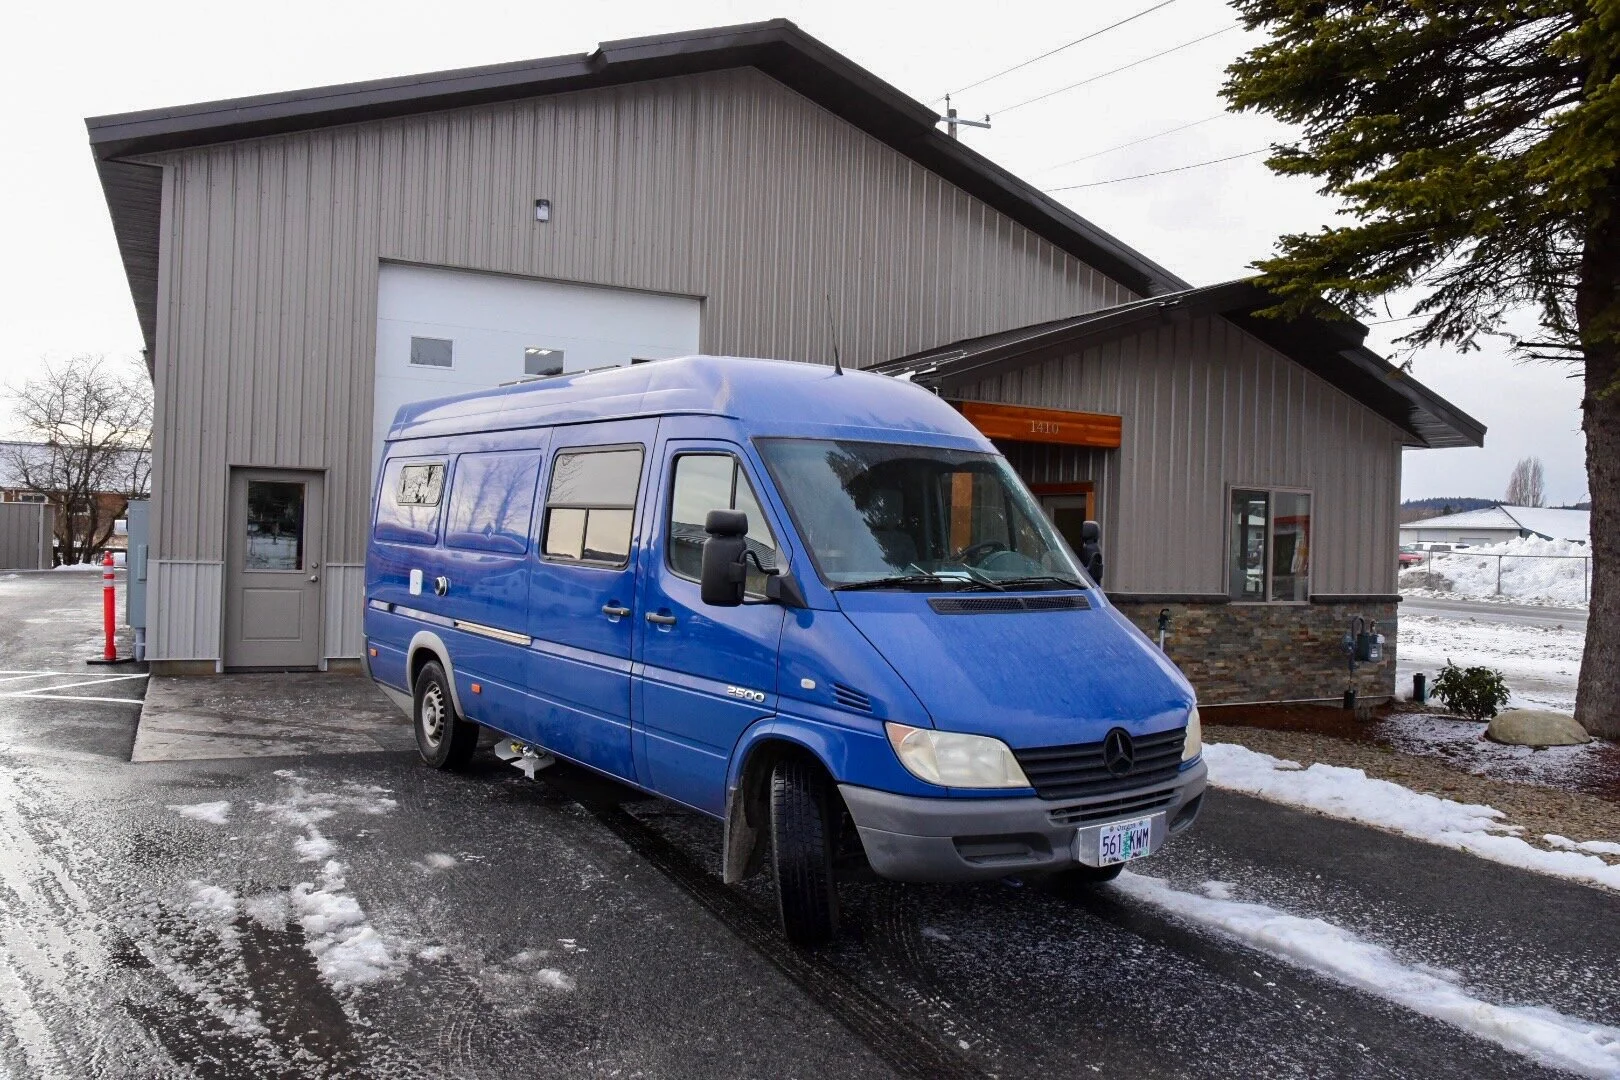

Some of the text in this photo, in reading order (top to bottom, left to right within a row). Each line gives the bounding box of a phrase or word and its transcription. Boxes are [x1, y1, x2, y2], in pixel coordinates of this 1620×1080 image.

[1030, 420, 1059, 434] 1410
[727, 685, 765, 703] 2500
[1116, 823, 1136, 831] Oregon
[1102, 827, 1149, 857] 561 KWM
